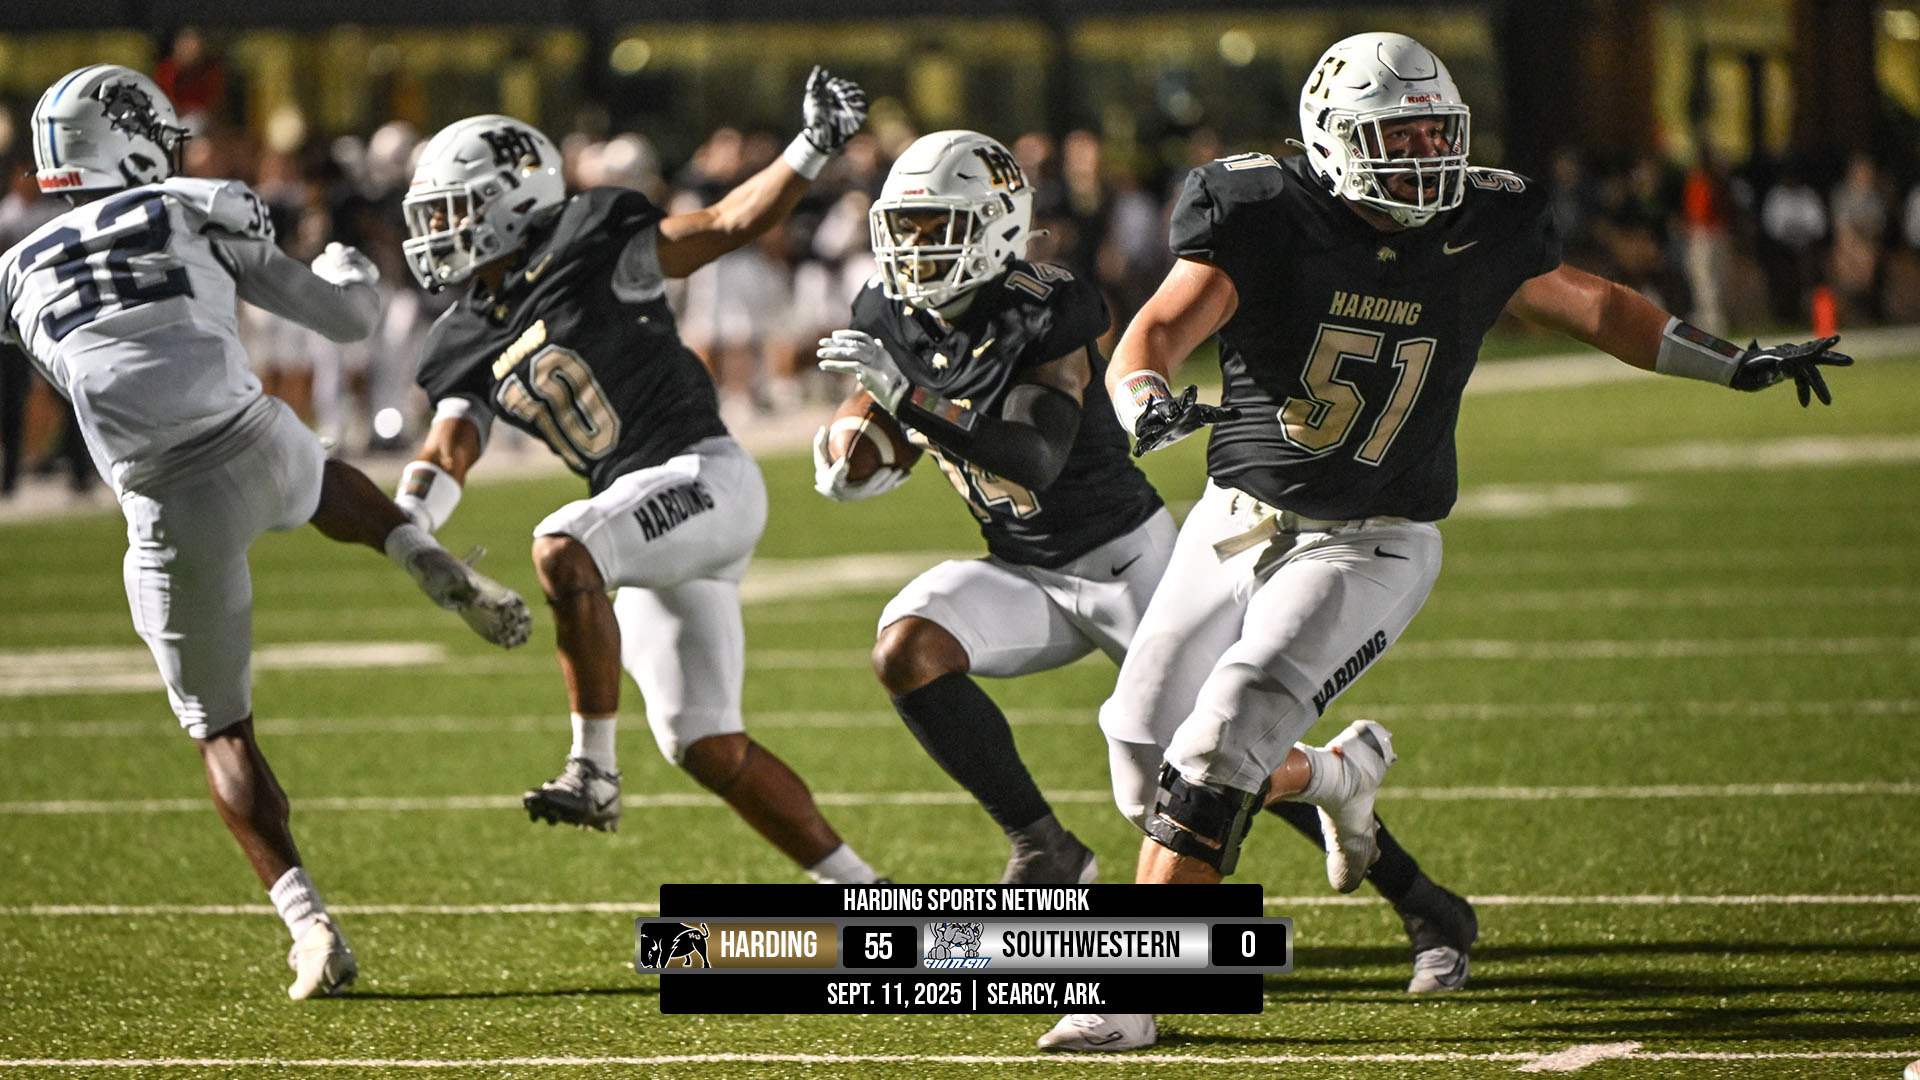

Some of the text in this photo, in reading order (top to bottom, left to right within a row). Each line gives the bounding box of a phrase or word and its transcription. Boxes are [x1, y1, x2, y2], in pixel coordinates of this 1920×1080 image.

[1309, 56, 1347, 99] 51
[1407, 93, 1442, 103] Riddll
[18, 190, 195, 342] 32
[1328, 290, 1423, 327] HARDING
[496, 343, 623, 471] 10
[1276, 322, 1438, 467] 51
